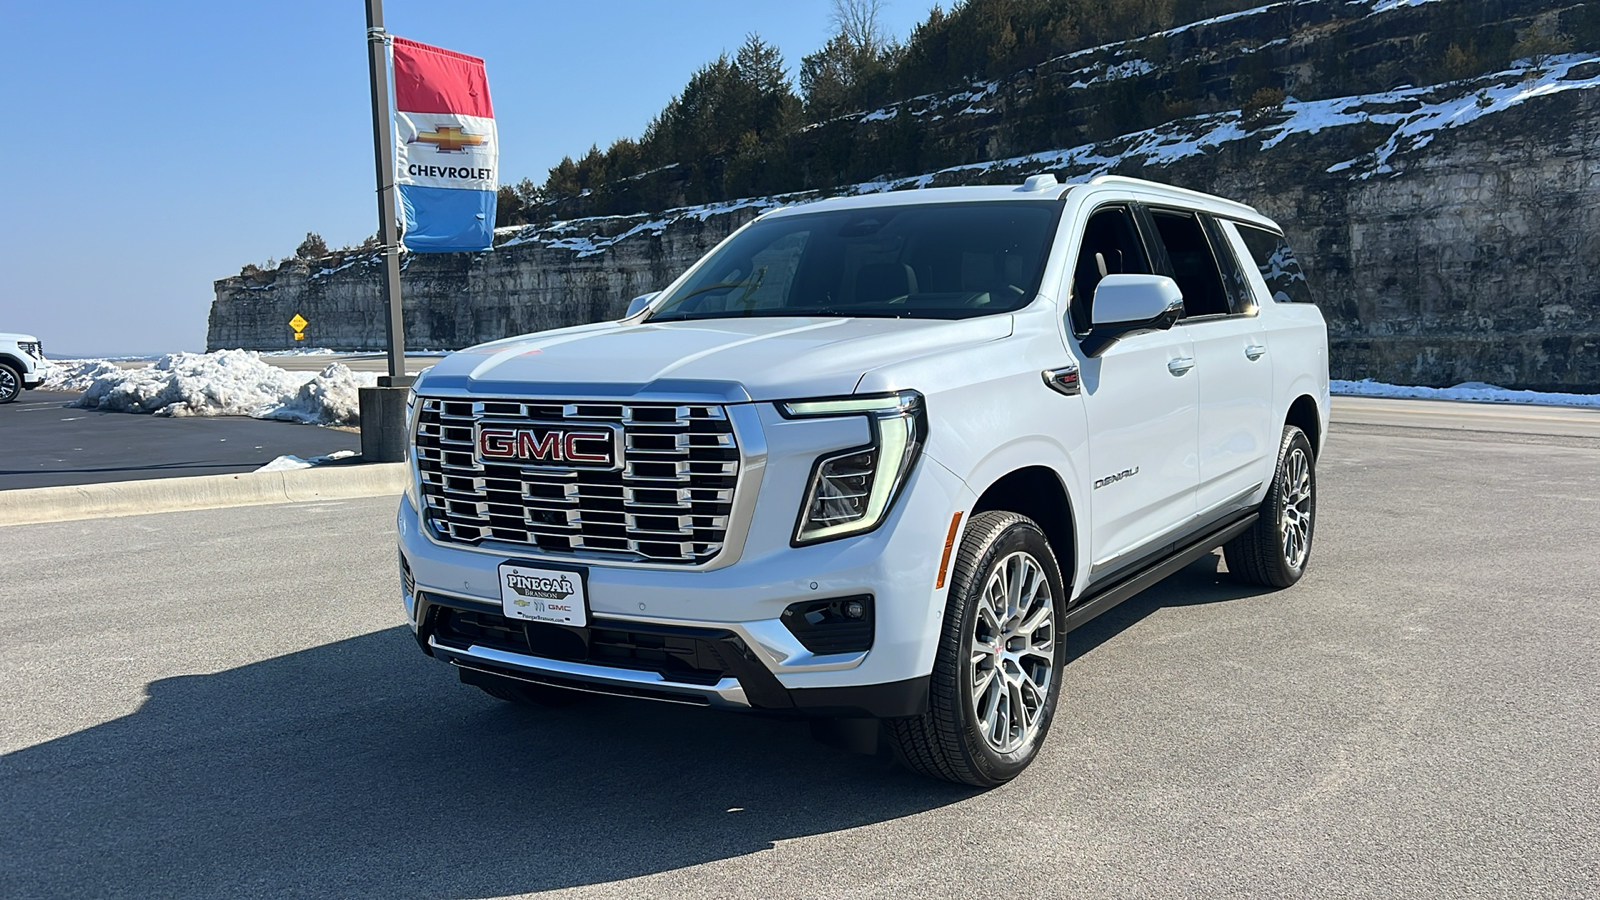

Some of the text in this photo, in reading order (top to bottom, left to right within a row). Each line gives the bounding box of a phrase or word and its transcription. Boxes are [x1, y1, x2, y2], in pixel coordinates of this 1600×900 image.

[409, 164, 492, 180] CHEVROLET
[480, 428, 610, 463] GMC
[1093, 465, 1139, 490] DENALI
[507, 575, 574, 594] PINEGAR
[548, 604, 572, 612] GMC
